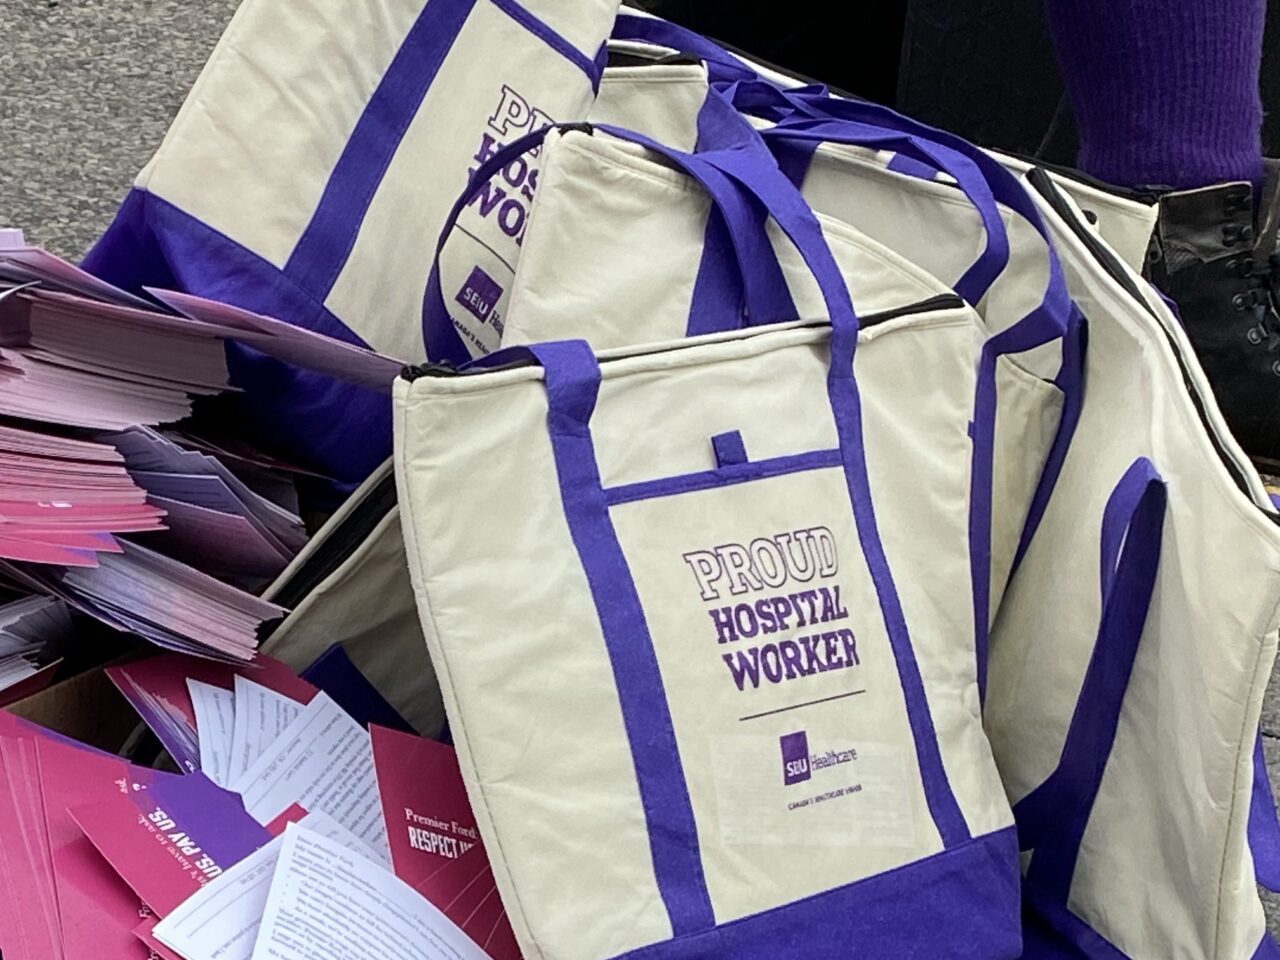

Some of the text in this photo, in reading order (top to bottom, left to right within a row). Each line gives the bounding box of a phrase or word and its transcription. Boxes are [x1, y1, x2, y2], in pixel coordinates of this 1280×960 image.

[463, 286, 488, 317] SEIU
[682, 525, 839, 602] PROUD
[708, 585, 849, 644] HOSPITAL
[722, 628, 860, 691] WORKER
[148, 807, 176, 830] US.
[404, 808, 449, 831] Premier
[156, 834, 168, 844] to
[168, 832, 201, 855] PAY
[408, 826, 458, 859] RESPECT
[167, 841, 192, 870] have
[195, 854, 222, 883] US.
